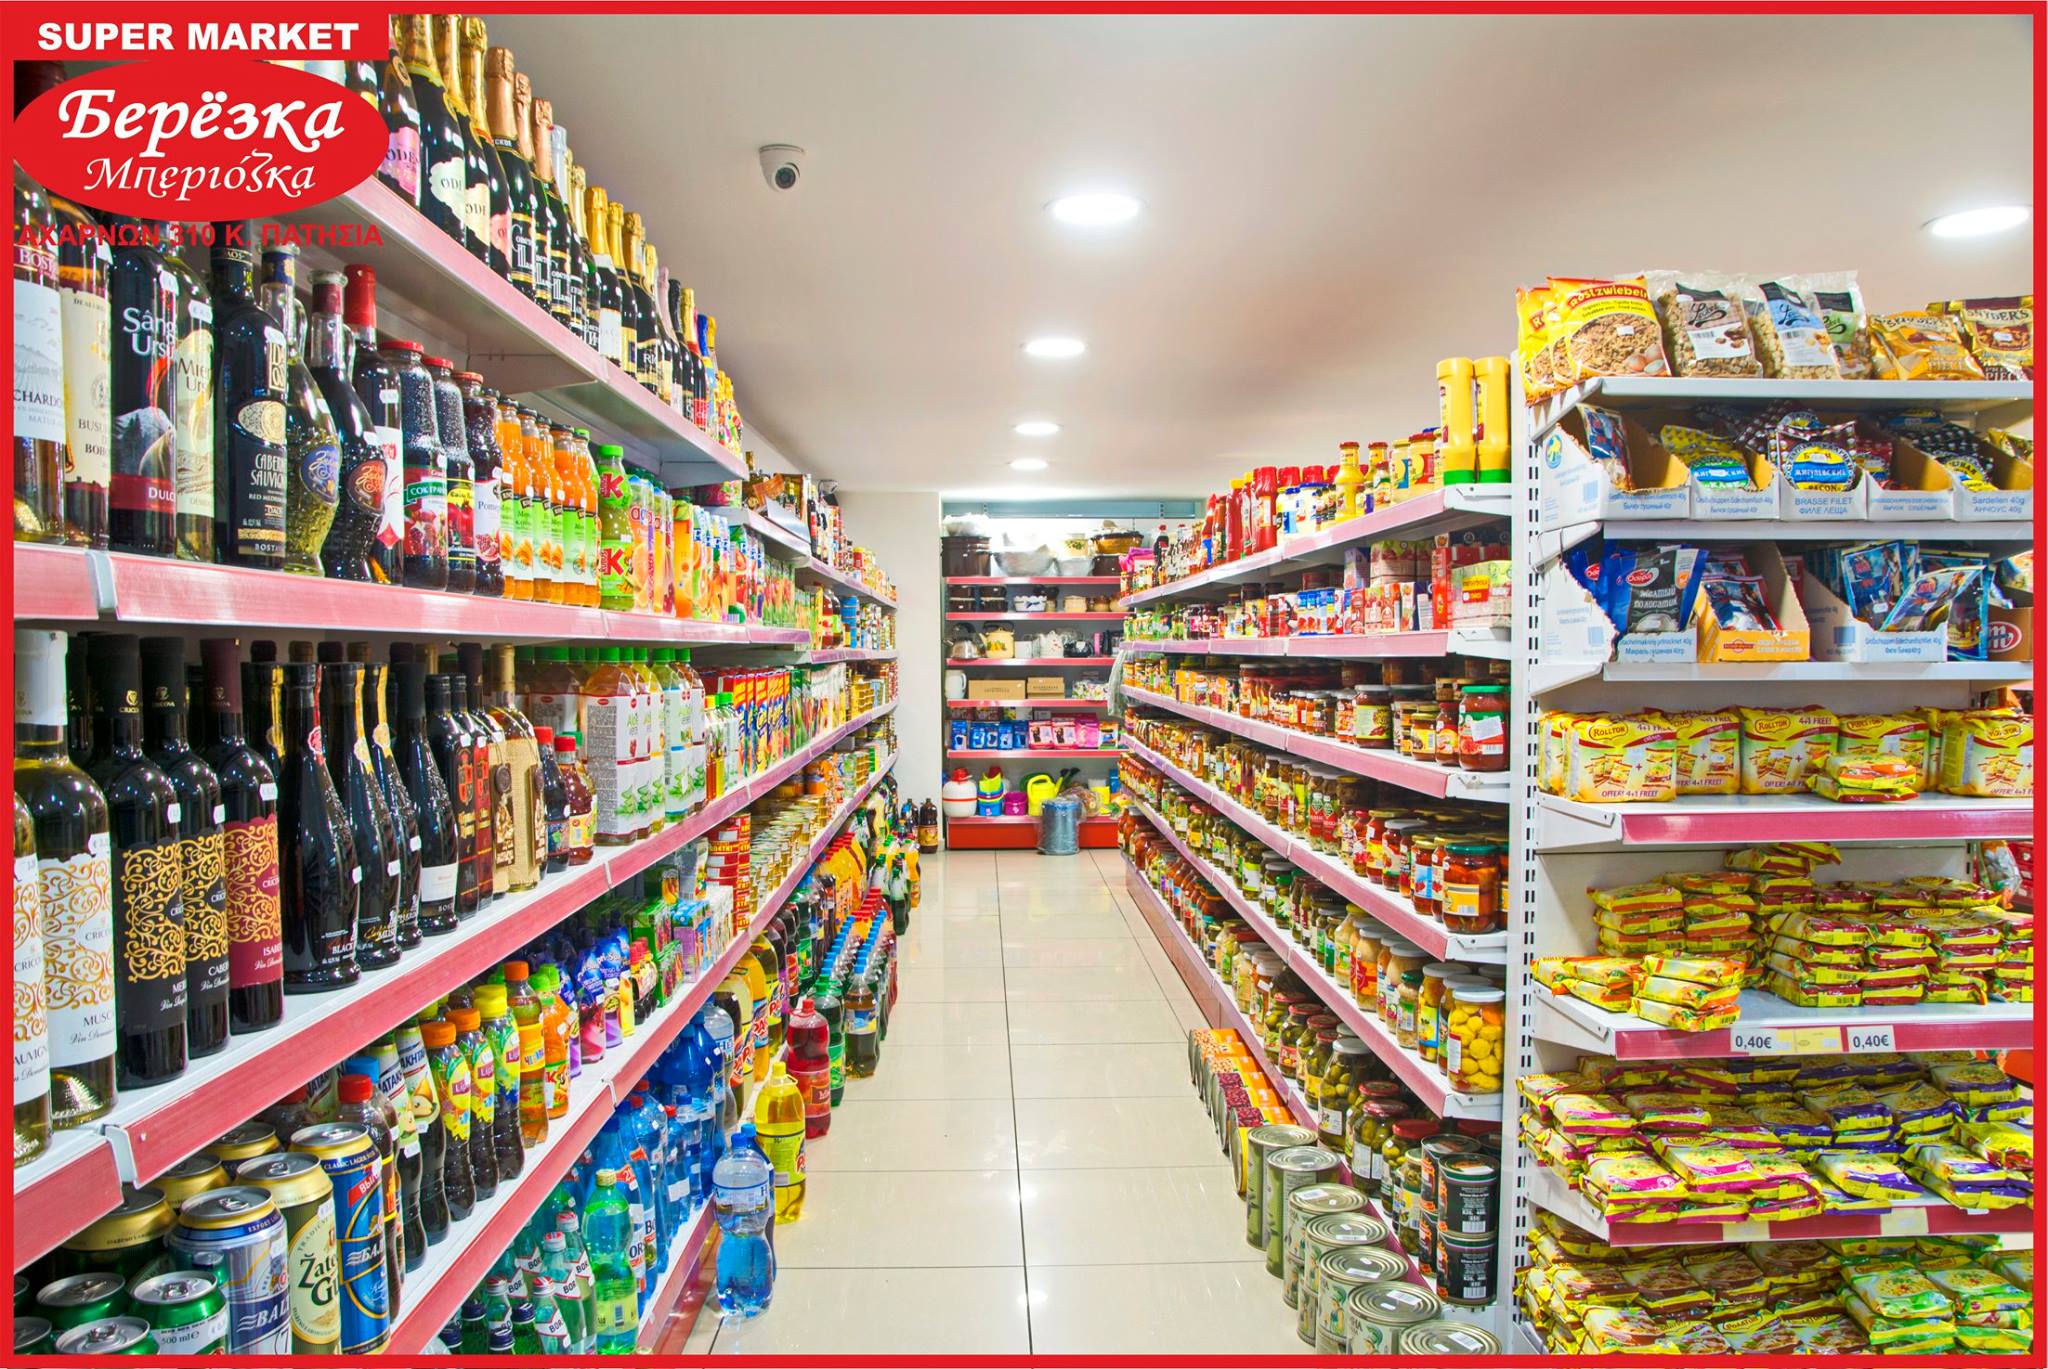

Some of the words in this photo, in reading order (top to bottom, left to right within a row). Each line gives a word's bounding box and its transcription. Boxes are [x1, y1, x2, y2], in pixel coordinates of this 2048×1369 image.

[1593, 726, 1626, 737] ROLLTON
[1735, 1035, 1772, 1049] 0,40€
[1853, 1034, 1889, 1049] 0,40€
